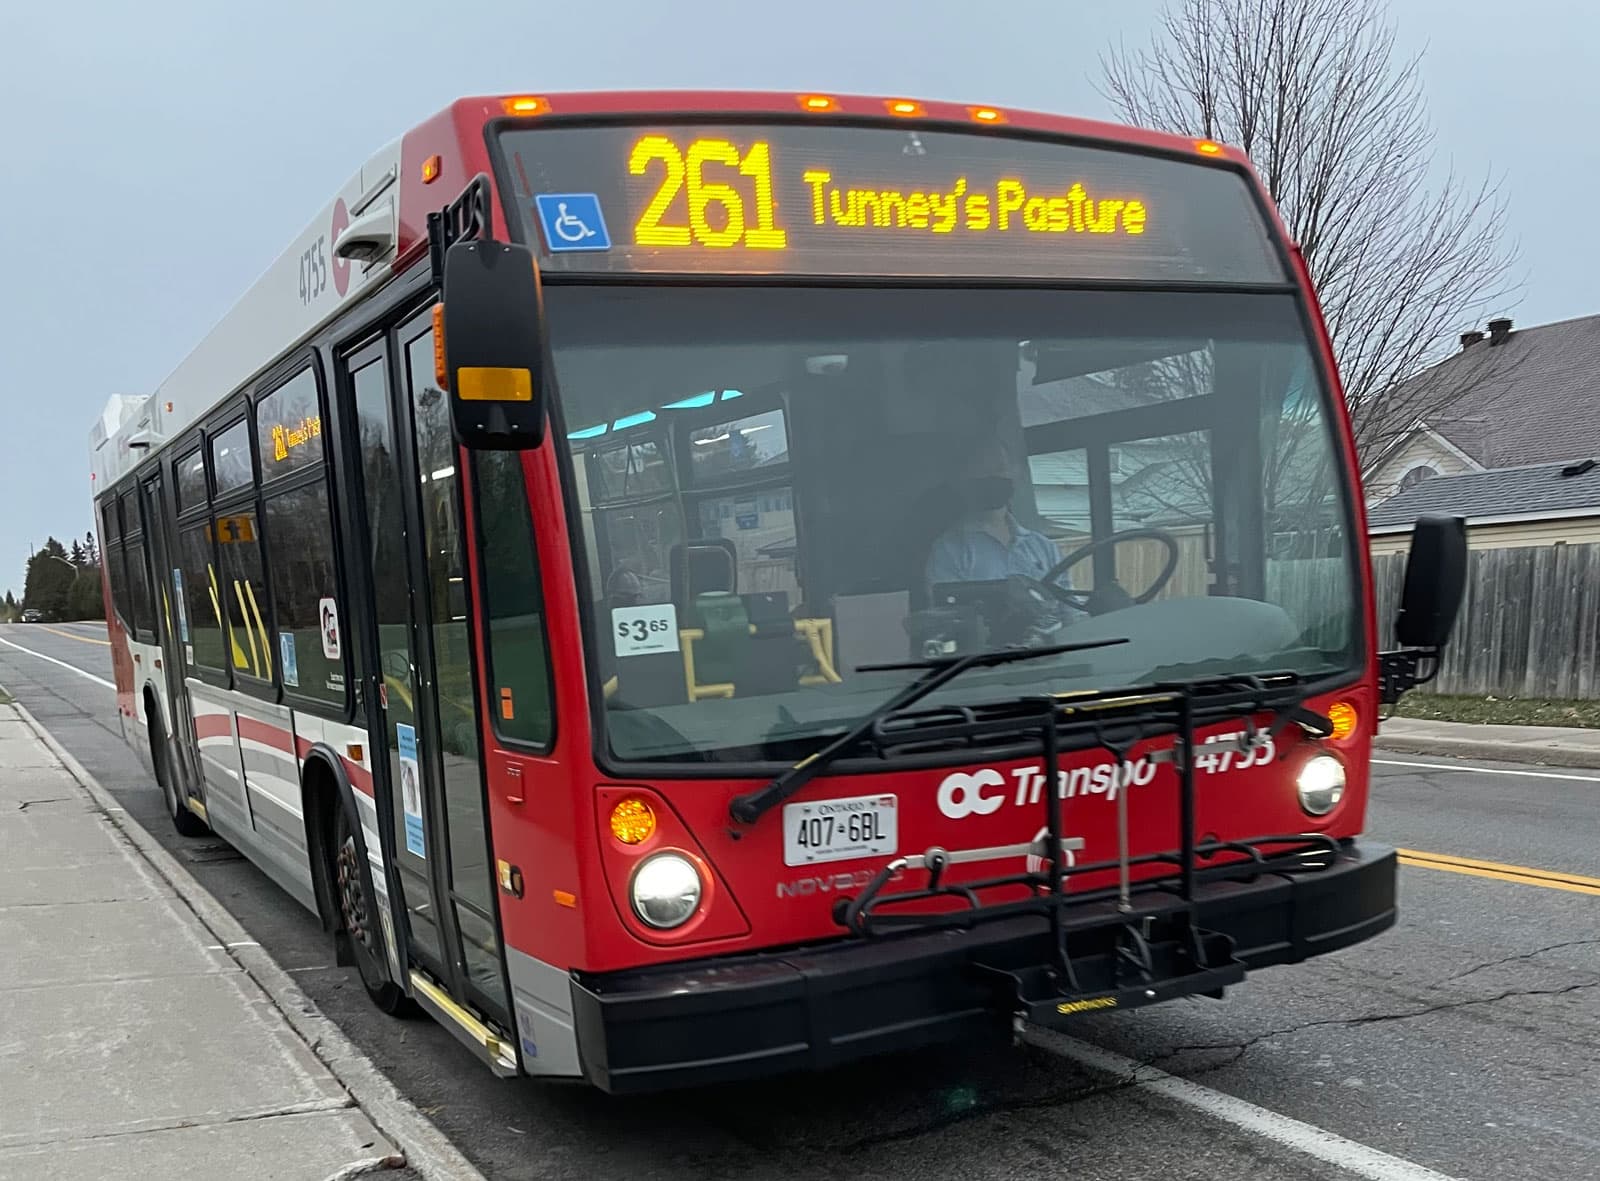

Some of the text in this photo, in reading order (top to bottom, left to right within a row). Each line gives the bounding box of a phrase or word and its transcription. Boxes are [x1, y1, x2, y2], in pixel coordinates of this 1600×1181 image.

[628, 136, 1146, 248] 261 Tunney's Pasture
[299, 235, 326, 305] 4755
[937, 768, 1006, 819] OC
